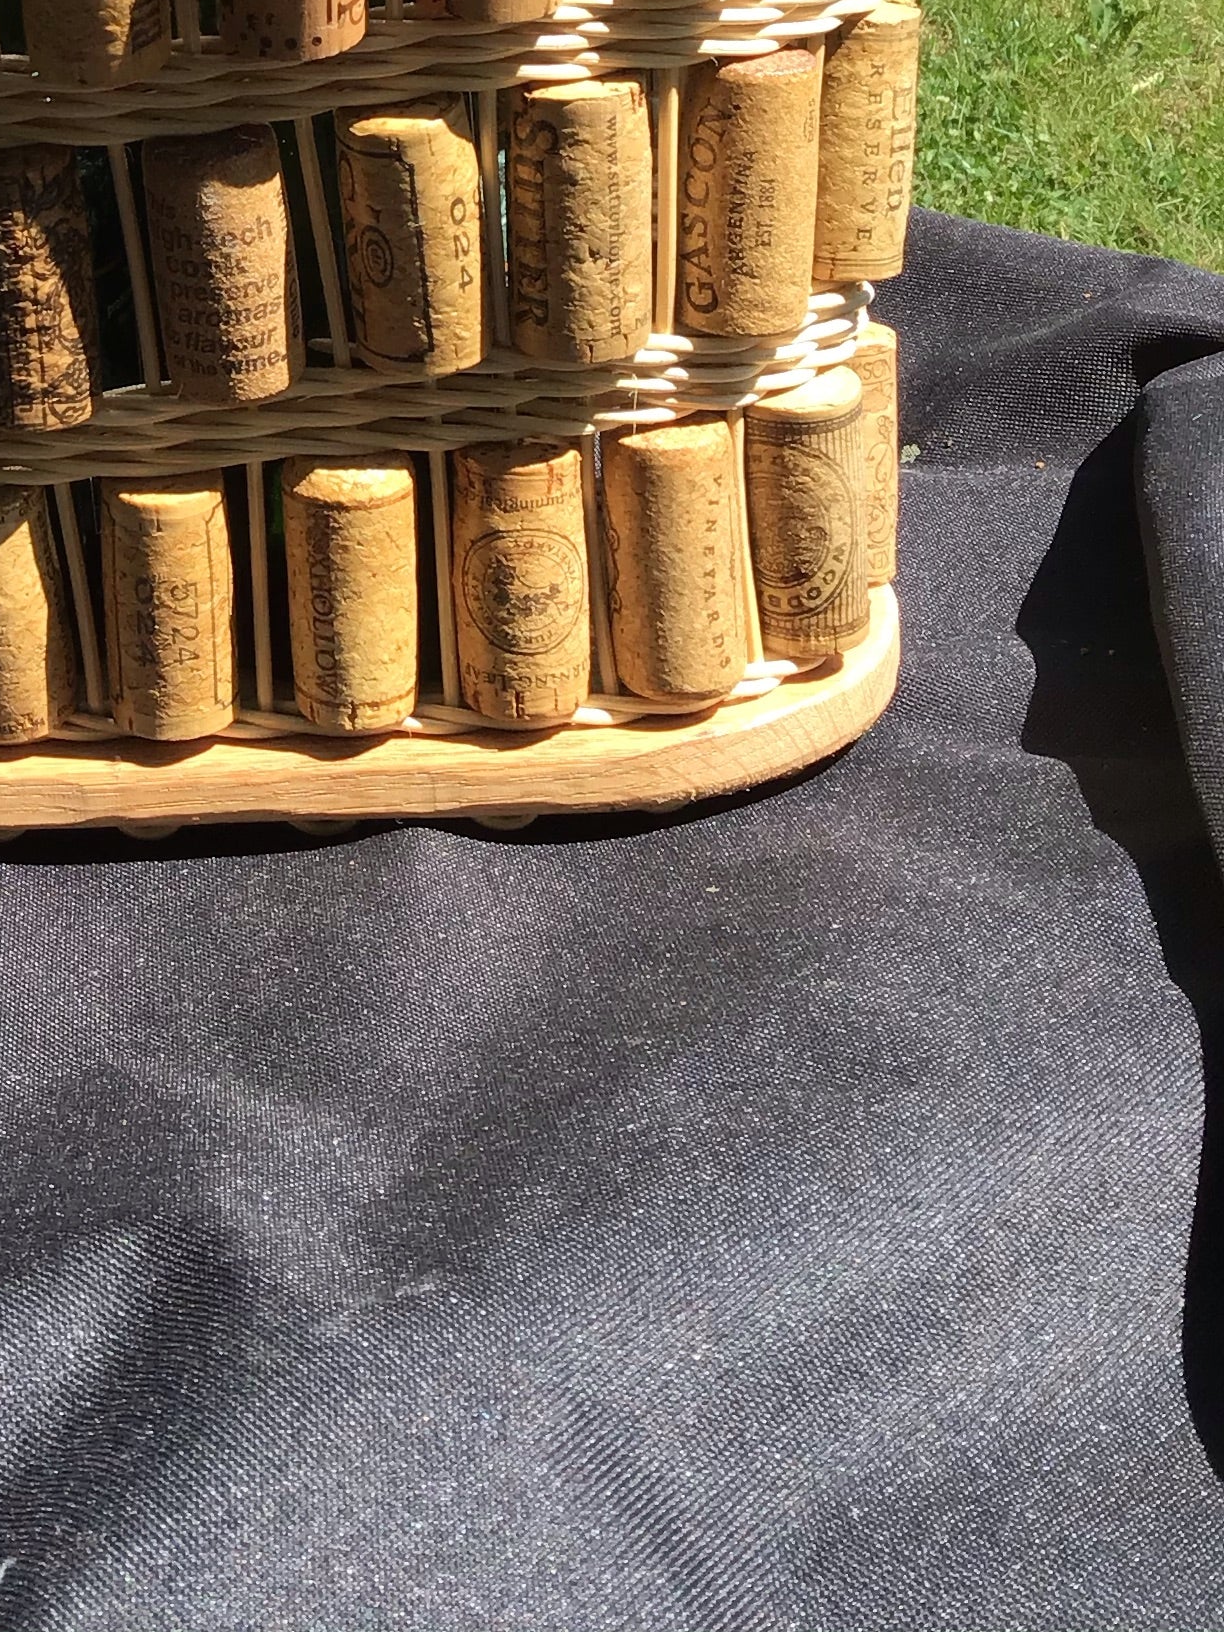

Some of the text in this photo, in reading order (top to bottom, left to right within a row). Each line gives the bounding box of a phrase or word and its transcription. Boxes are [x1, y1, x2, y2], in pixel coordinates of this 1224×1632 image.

[856, 63, 886, 242] RESERVE
[450, 197, 475, 295] 024
[702, 473, 732, 670] VINEYARDS
